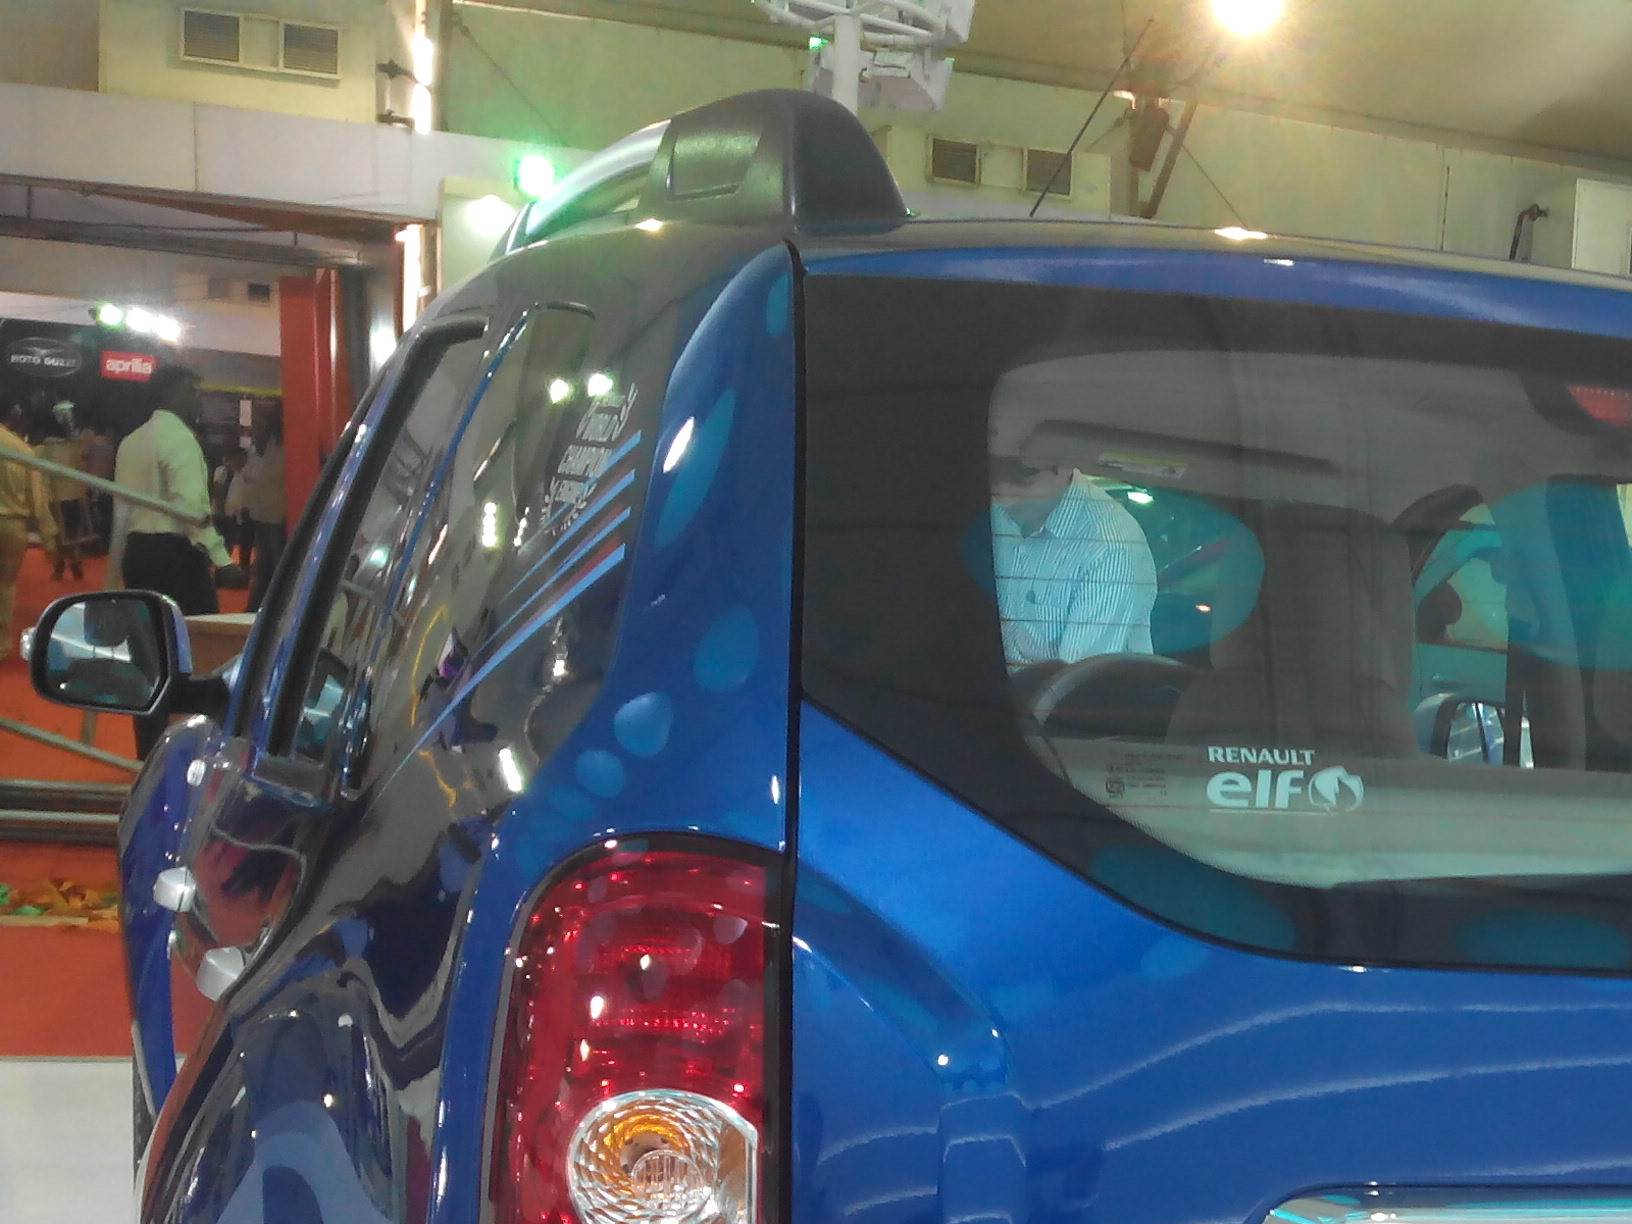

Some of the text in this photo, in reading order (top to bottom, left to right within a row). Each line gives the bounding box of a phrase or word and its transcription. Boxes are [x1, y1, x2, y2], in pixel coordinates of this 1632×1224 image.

[105, 357, 152, 375] aprilia
[1207, 746, 1316, 765] RENAULT
[1206, 769, 1305, 809] elf
